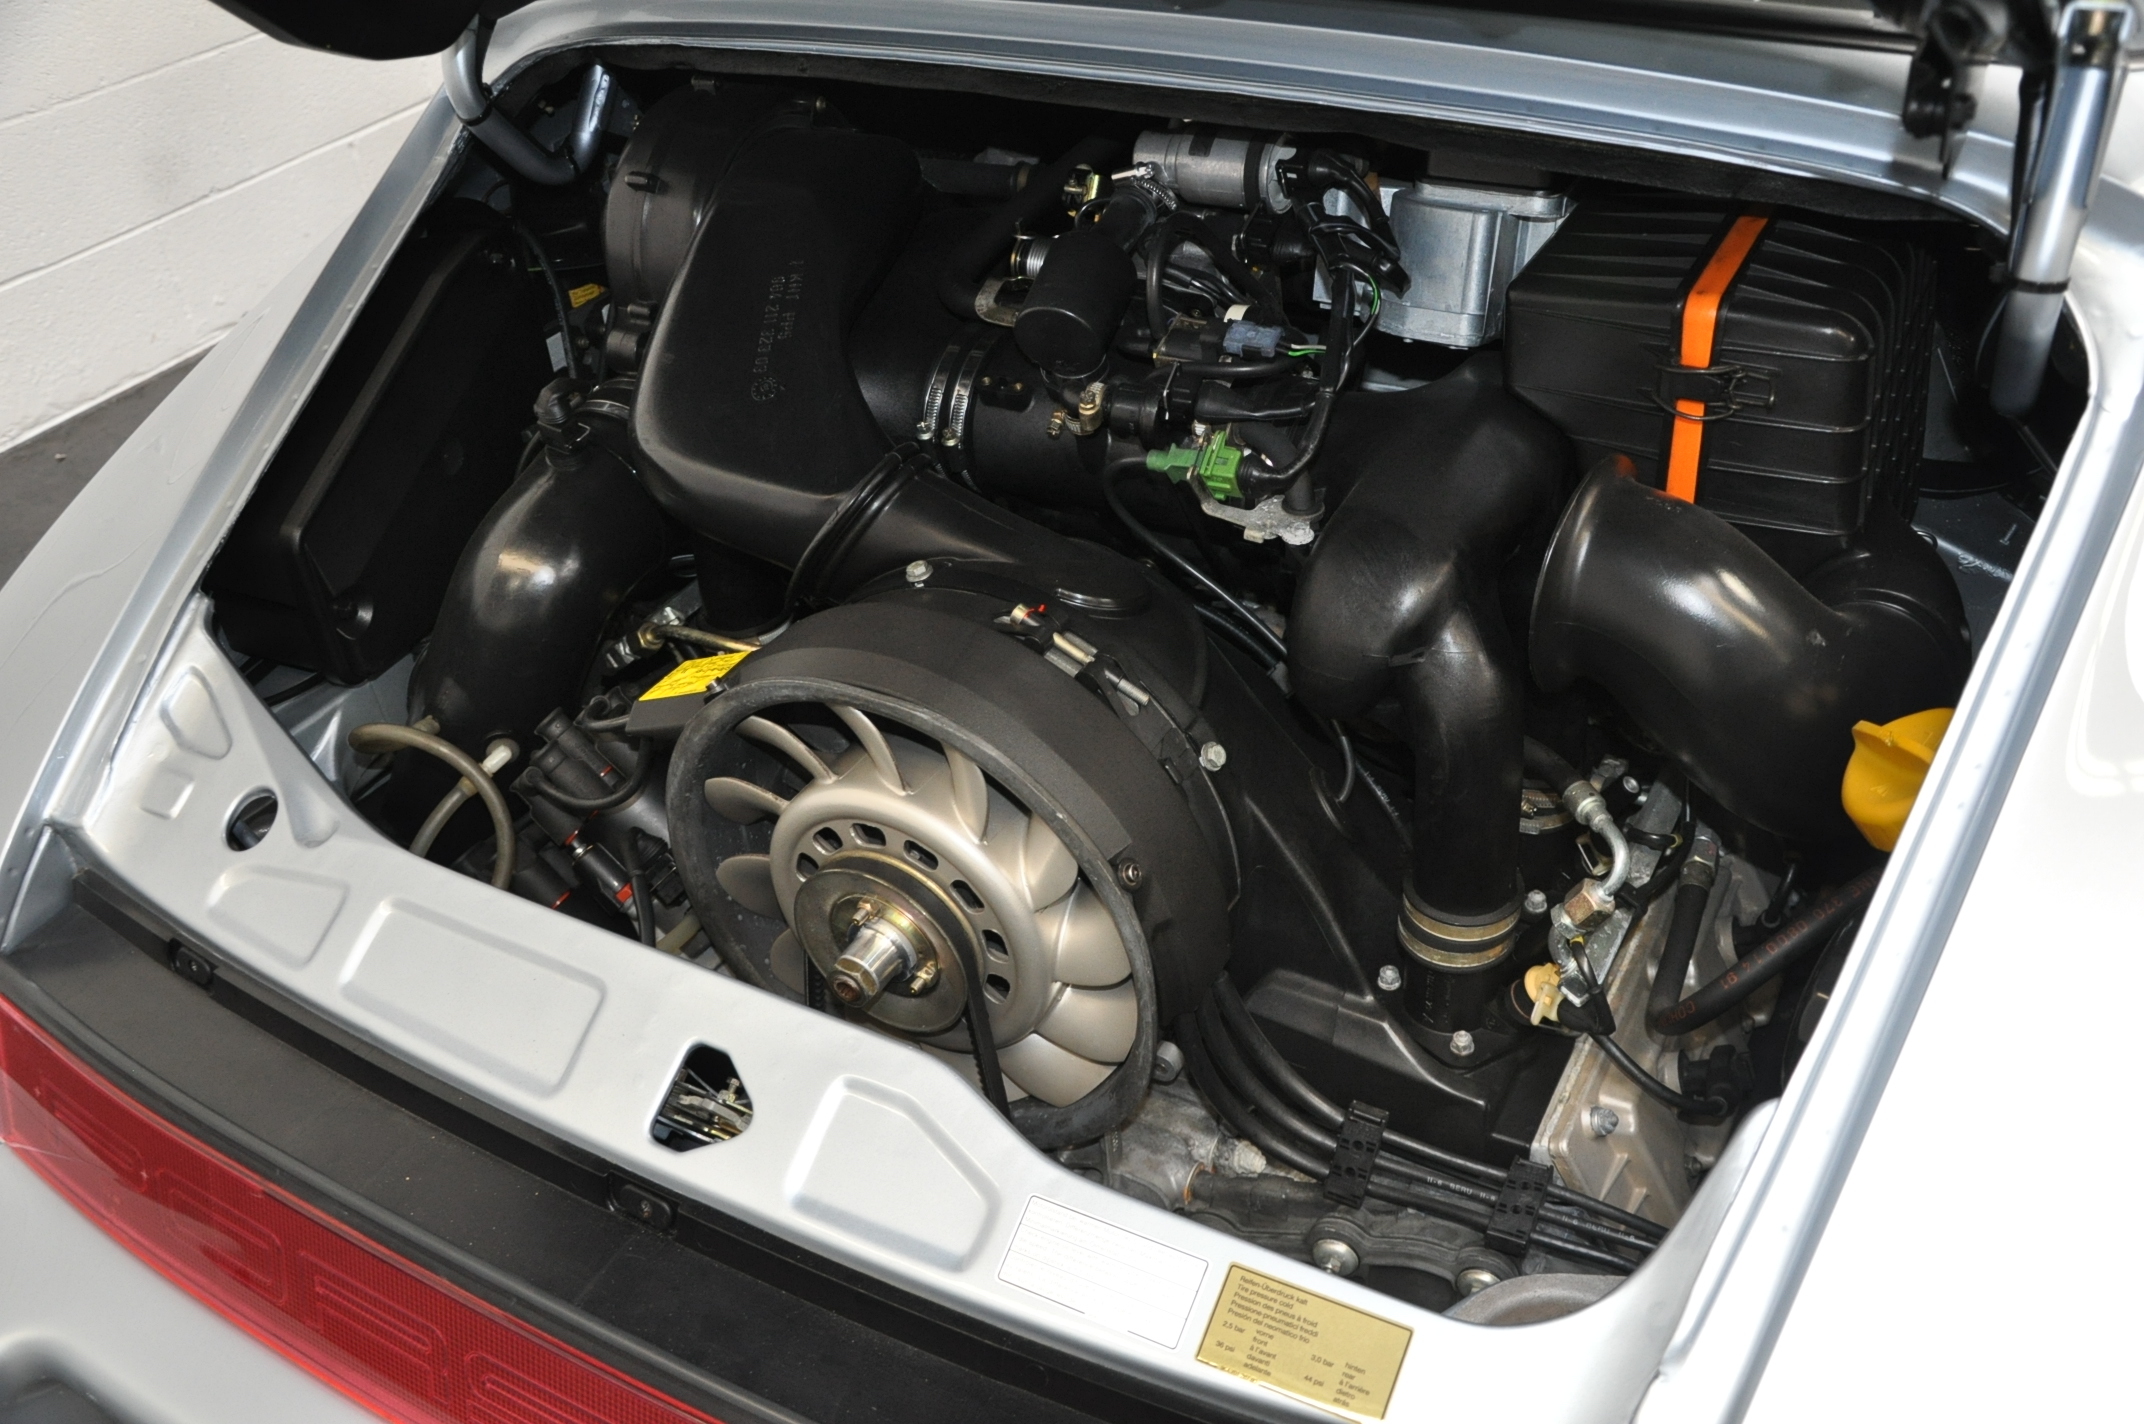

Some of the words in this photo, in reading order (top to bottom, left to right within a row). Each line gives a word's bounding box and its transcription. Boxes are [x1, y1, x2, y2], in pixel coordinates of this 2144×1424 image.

[1813, 897, 1844, 920] 370
[1237, 1283, 1249, 1293] Tire
[1249, 1287, 1278, 1304] pressure
[1278, 1299, 1294, 1310] cold
[1295, 1296, 1308, 1306] kalt
[1233, 1291, 1262, 1306] Pression
[1262, 1302, 1274, 1312] des
[1275, 1307, 1296, 1320] pneus
[1302, 1316, 1318, 1328] froid
[1252, 1317, 1264, 1326] del
[1233, 1324, 1246, 1334] bar
[1255, 1329, 1275, 1340] vorne
[1299, 1325, 1319, 1338] freddi
[1215, 1340, 1225, 1349] 36
[1224, 1343, 1236, 1353] psi
[1252, 1336, 1268, 1347] front
[1246, 1353, 1271, 1367] davanti
[1310, 1354, 1322, 1364] 3,0
[1322, 1358, 1335, 1368] bar
[1243, 1361, 1272, 1377] adelante
[1344, 1362, 1366, 1375] hinten
[1303, 1374, 1313, 1383] 44
[1312, 1378, 1325, 1387] psi
[1341, 1371, 1356, 1381] rear
[1335, 1388, 1356, 1400] dietro
